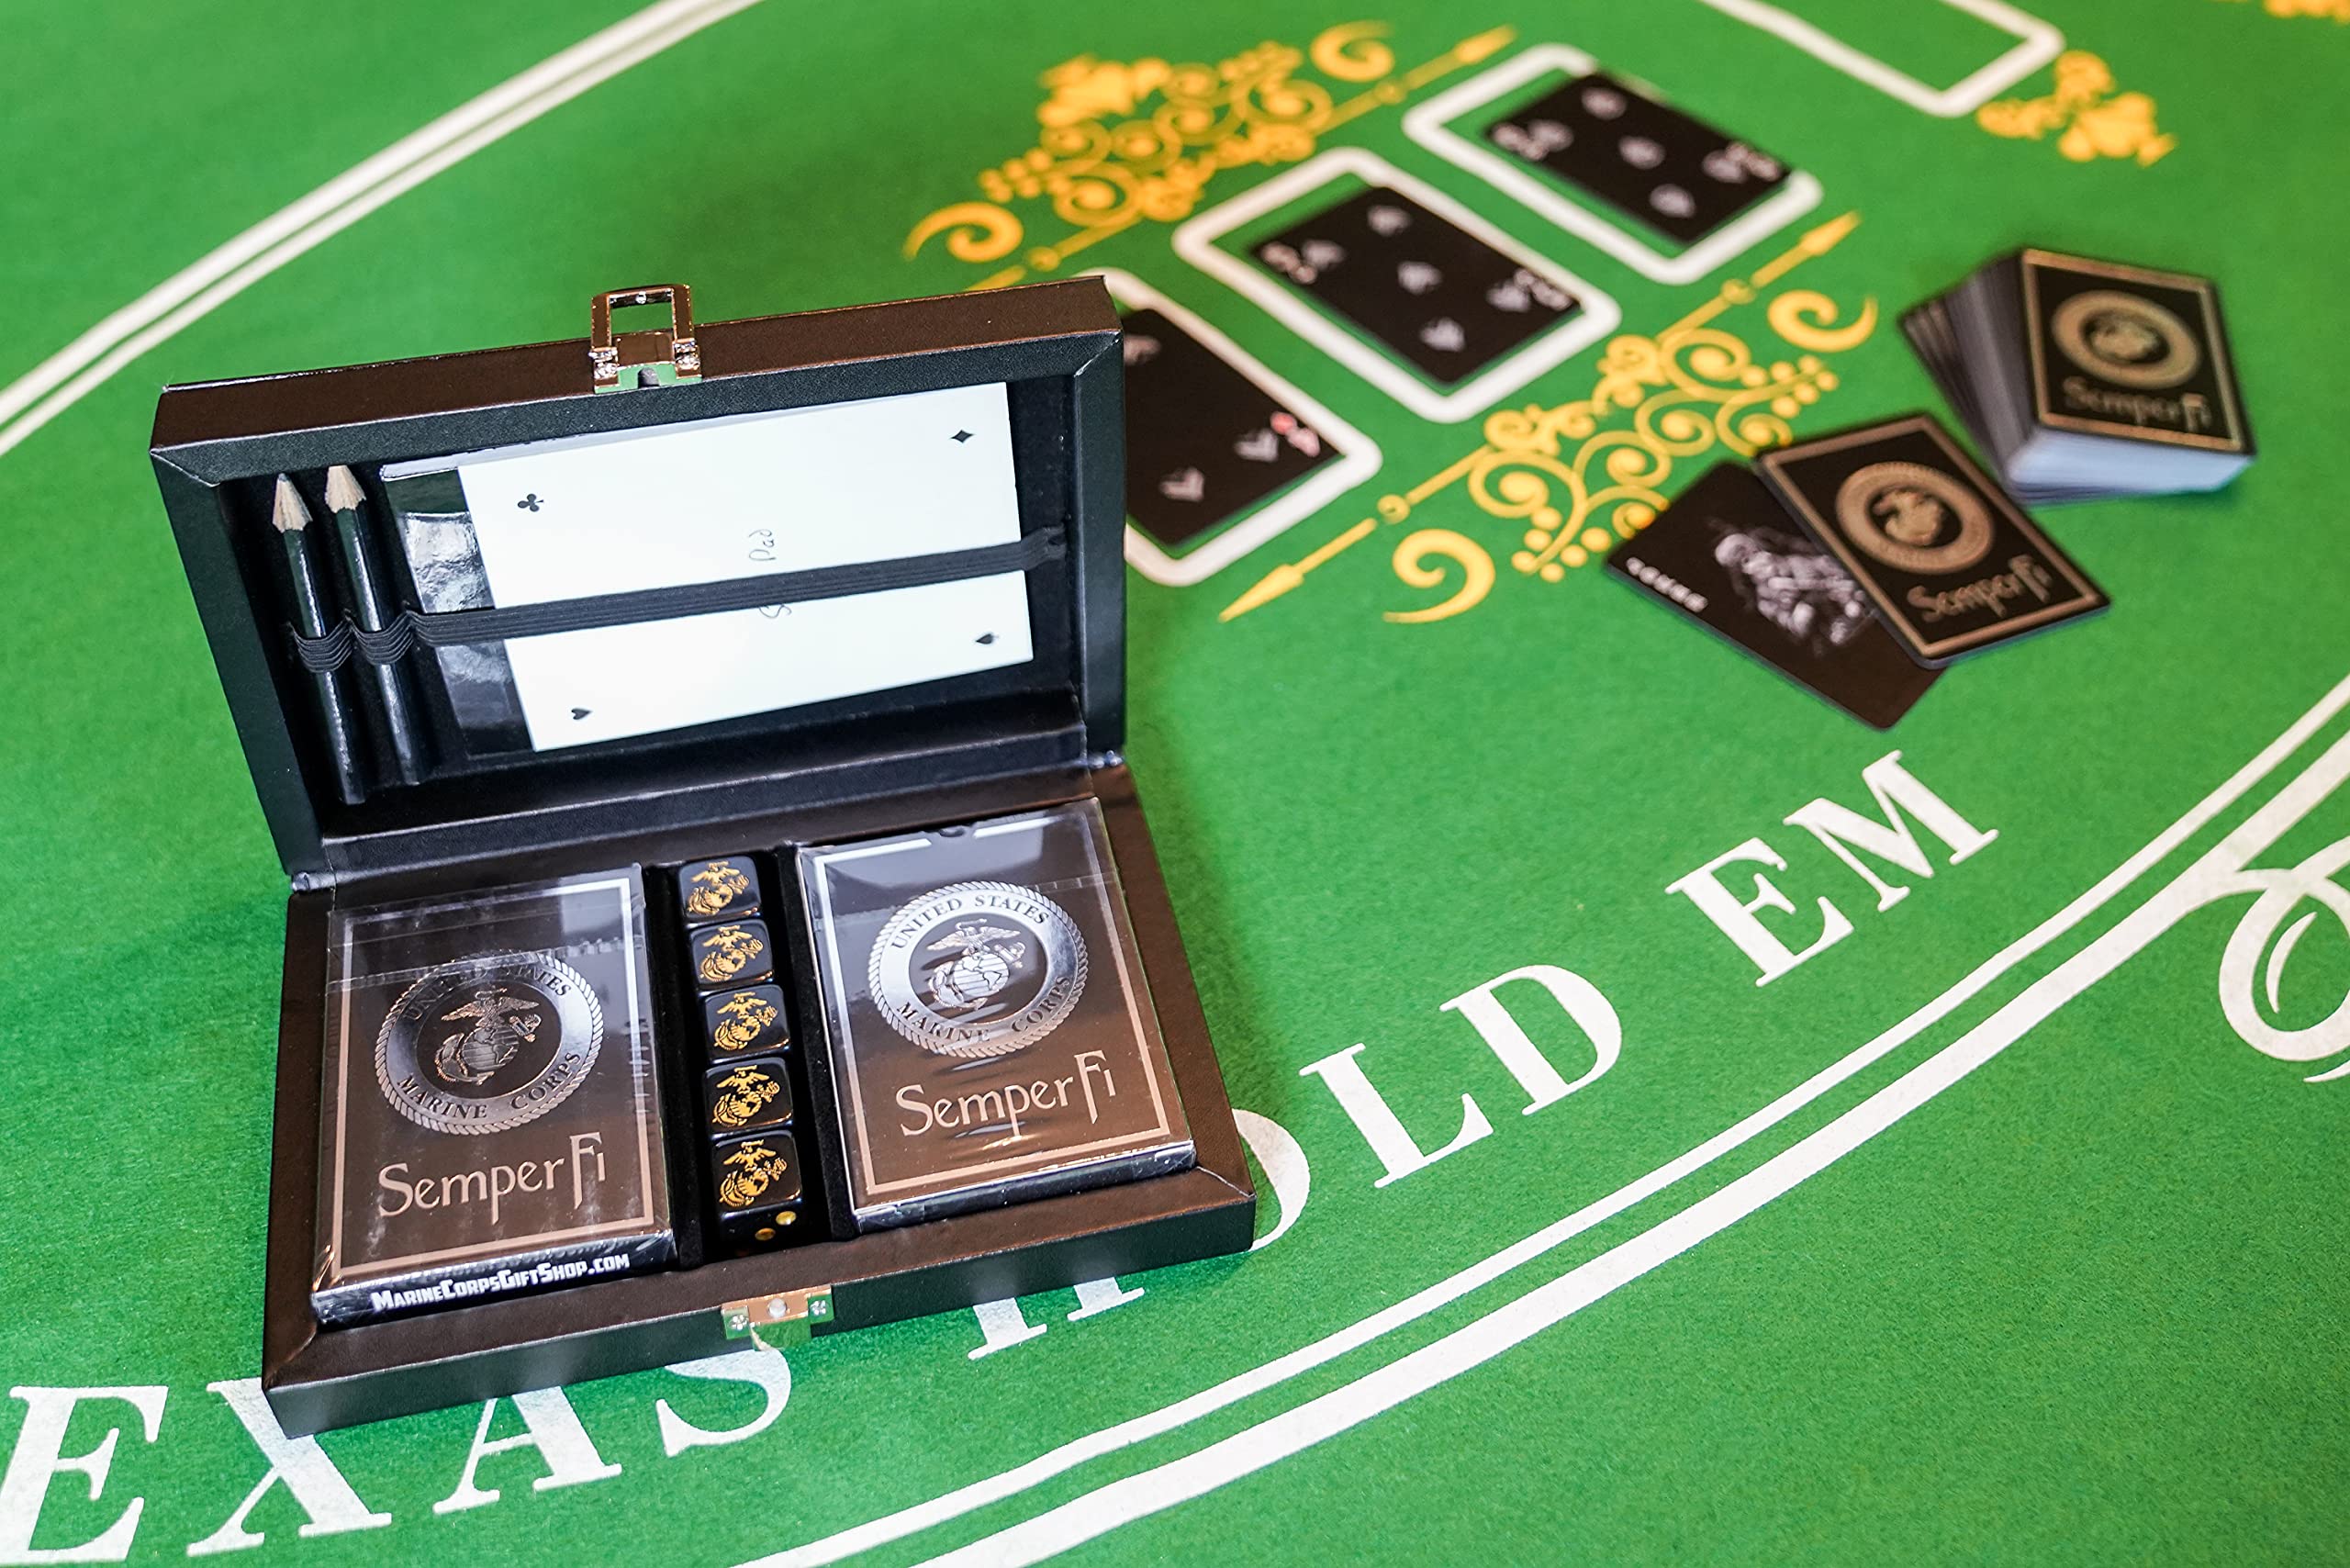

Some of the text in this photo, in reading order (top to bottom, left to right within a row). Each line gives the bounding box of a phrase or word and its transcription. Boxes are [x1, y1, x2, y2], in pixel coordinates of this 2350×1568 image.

[1664, 749, 1998, 988] EM
[891, 894, 1050, 950] UNITED STATES
[896, 975, 1071, 1043] MARINE CORPS
[397, 1051, 582, 1120] MARINE CORPS
[895, 1049, 1116, 1137] Semper Fi
[377, 1131, 607, 1226] Semper Fi
